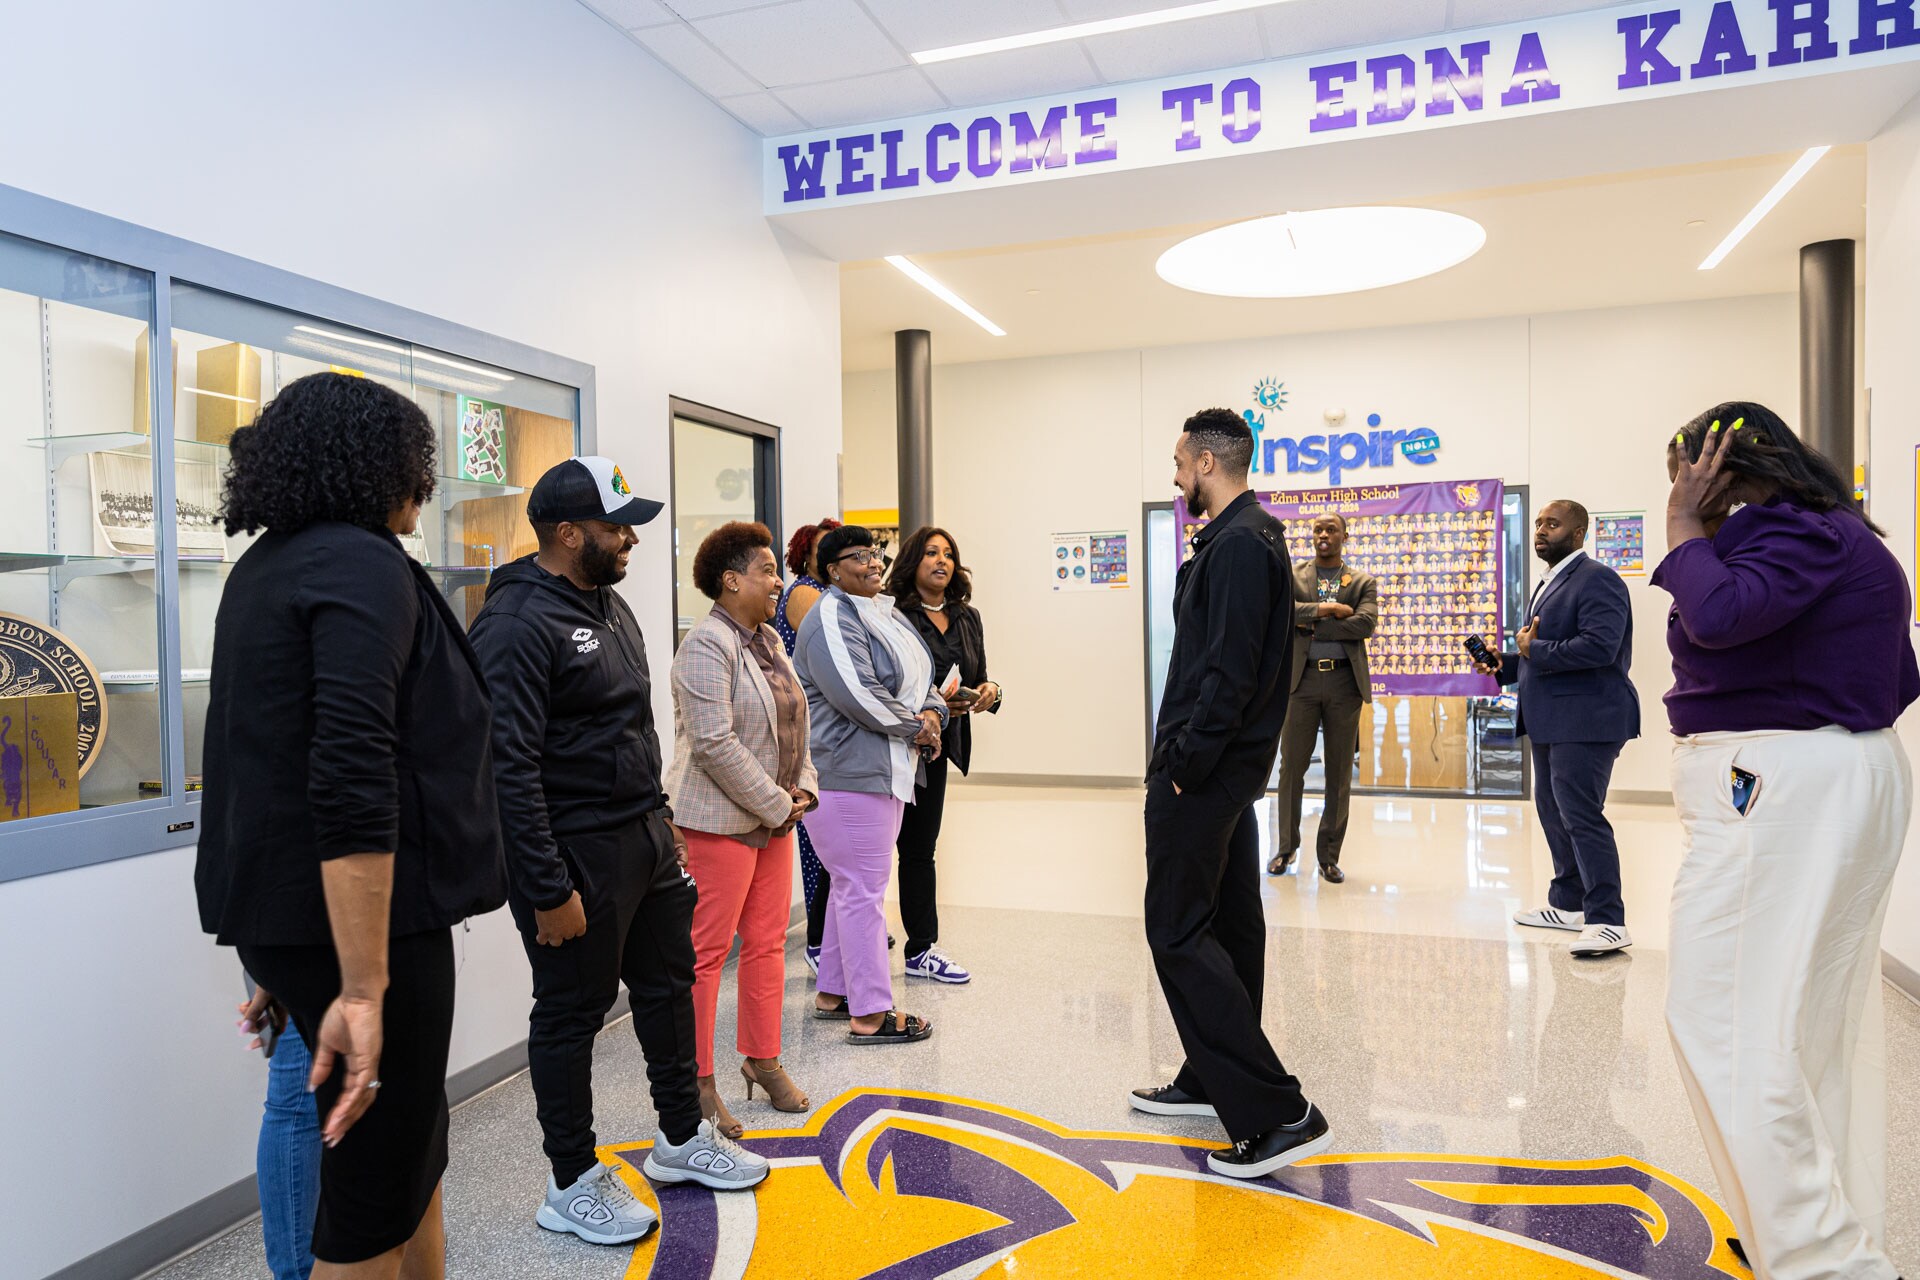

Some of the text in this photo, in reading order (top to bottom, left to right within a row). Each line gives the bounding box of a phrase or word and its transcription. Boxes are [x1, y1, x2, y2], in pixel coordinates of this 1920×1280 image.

[778, 97, 1117, 203] WELCOME
[1162, 77, 1261, 152] TO
[1309, 32, 1560, 133] EDNA
[1405, 440, 1436, 452] NOLA
[1270, 486, 1399, 505] Edna Karr High School
[1298, 502, 1359, 515] CLASS OF 2024
[576, 638, 600, 653] SHOCK
[50, 645, 95, 712] SCHOOL
[31, 729, 66, 790] COUGAR
